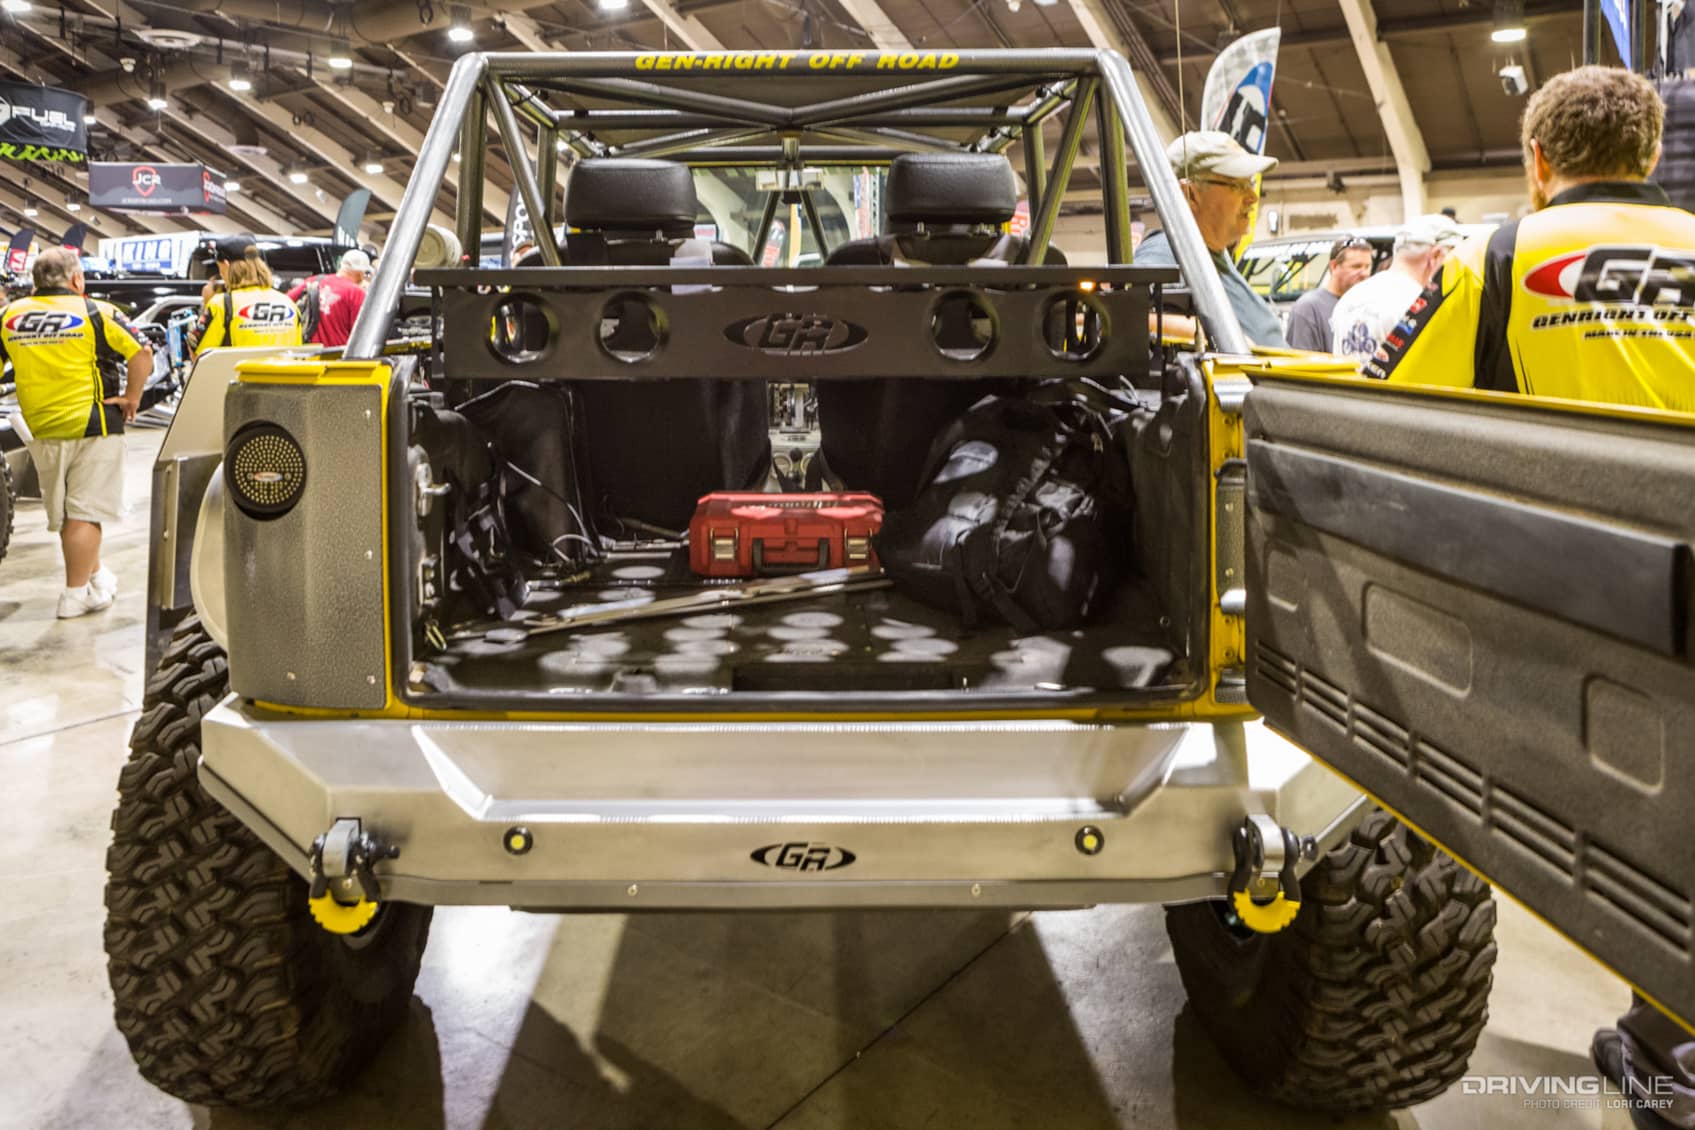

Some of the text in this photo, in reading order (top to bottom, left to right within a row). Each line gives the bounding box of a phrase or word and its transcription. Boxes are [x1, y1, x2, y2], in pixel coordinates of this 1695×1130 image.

[634, 53, 960, 70] GEN-RIGHT OFF ROAD
[511, 191, 535, 249] SPO
[775, 842, 831, 872] GR
